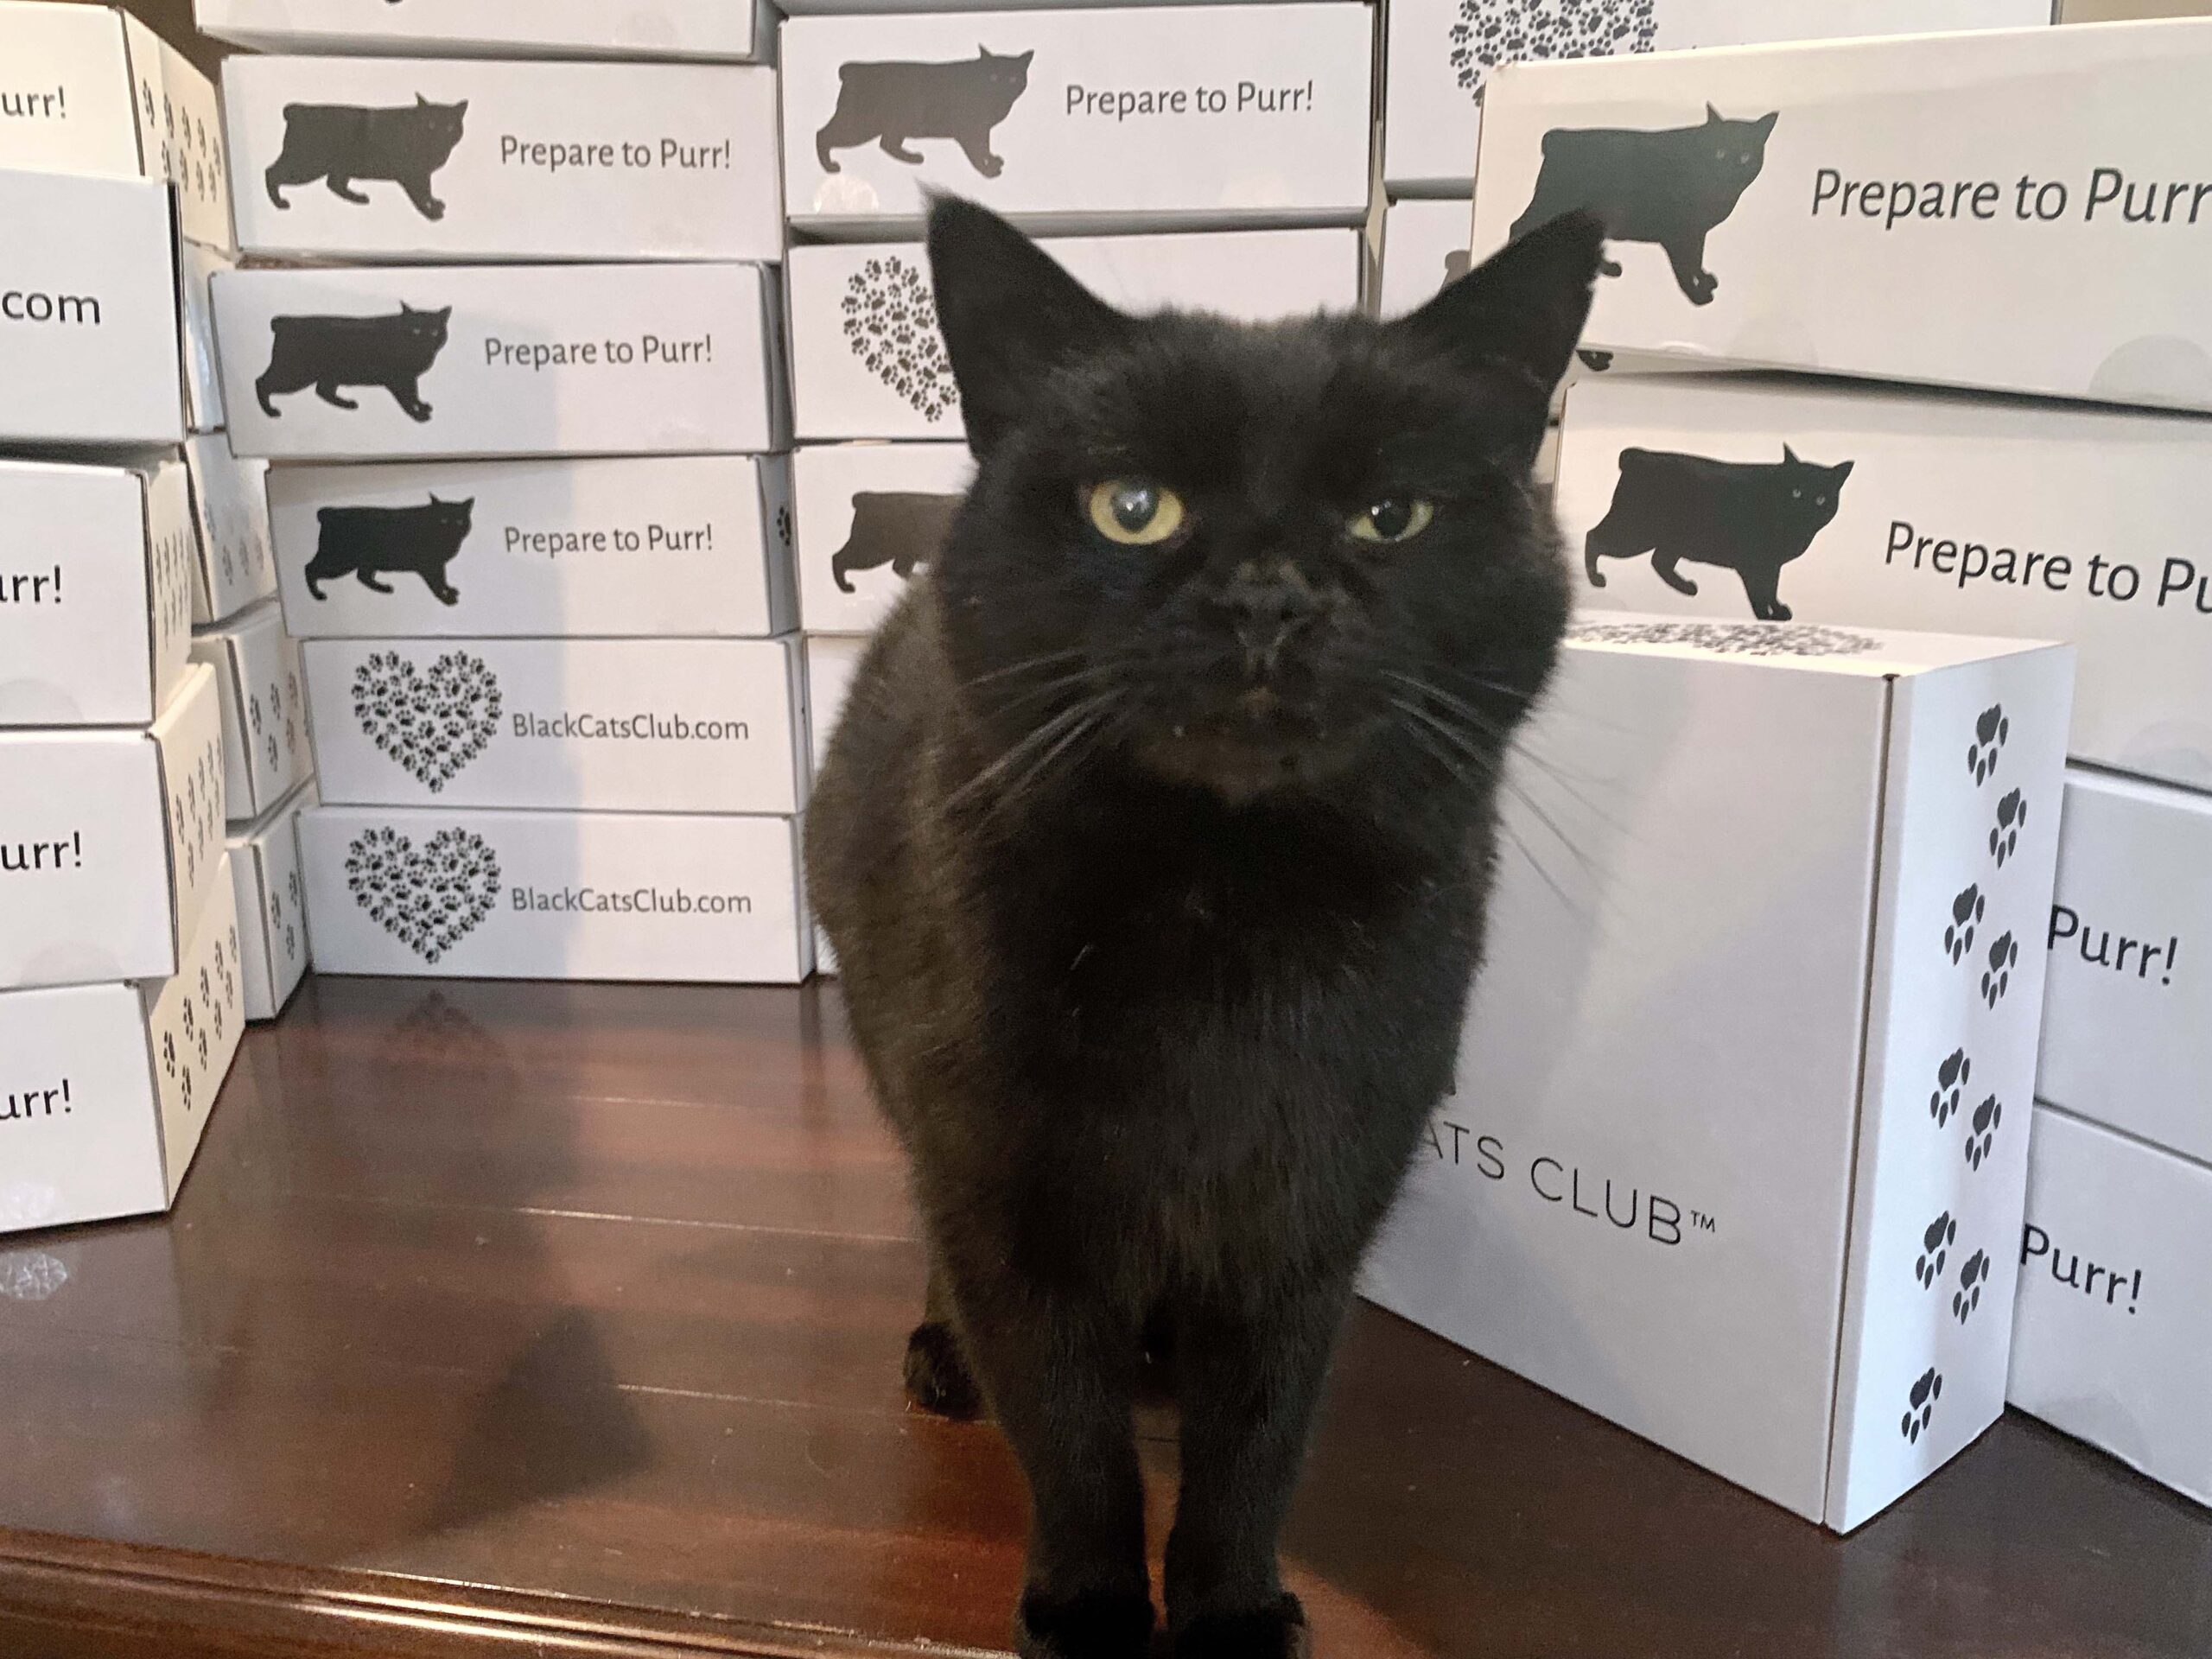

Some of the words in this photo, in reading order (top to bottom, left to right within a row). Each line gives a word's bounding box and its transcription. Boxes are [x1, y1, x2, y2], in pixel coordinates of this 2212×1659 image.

[1, 85, 66, 119] urr!
[1066, 85, 1187, 123] Prepare
[1195, 86, 1227, 113] to
[1237, 79, 1313, 112] Purr!
[500, 135, 614, 174] Prepare
[621, 142, 652, 168] to
[660, 138, 730, 169] Purr!
[1811, 168, 2000, 231] Prepare
[2015, 175, 2068, 221] to
[2084, 167, 2212, 225] Purr
[1, 290, 101, 326] com
[484, 337, 597, 372] Prepare
[604, 340, 633, 365] to
[642, 334, 712, 364] Purr!
[504, 524, 607, 559] Prepare
[613, 528, 640, 552] to
[647, 523, 713, 551] Purr!
[1885, 520, 2072, 591] Prepare
[2088, 554, 2140, 601] to
[511, 711, 749, 741] BlackCatsClub.com
[0, 830, 82, 871] urr!
[510, 885, 752, 914] BlackCatsClub.com
[2047, 903, 2178, 986] Purr!
[0, 1077, 72, 1122] urr!
[1422, 1117, 1506, 1181] ATS
[2019, 1222, 2143, 1315] Purr!
